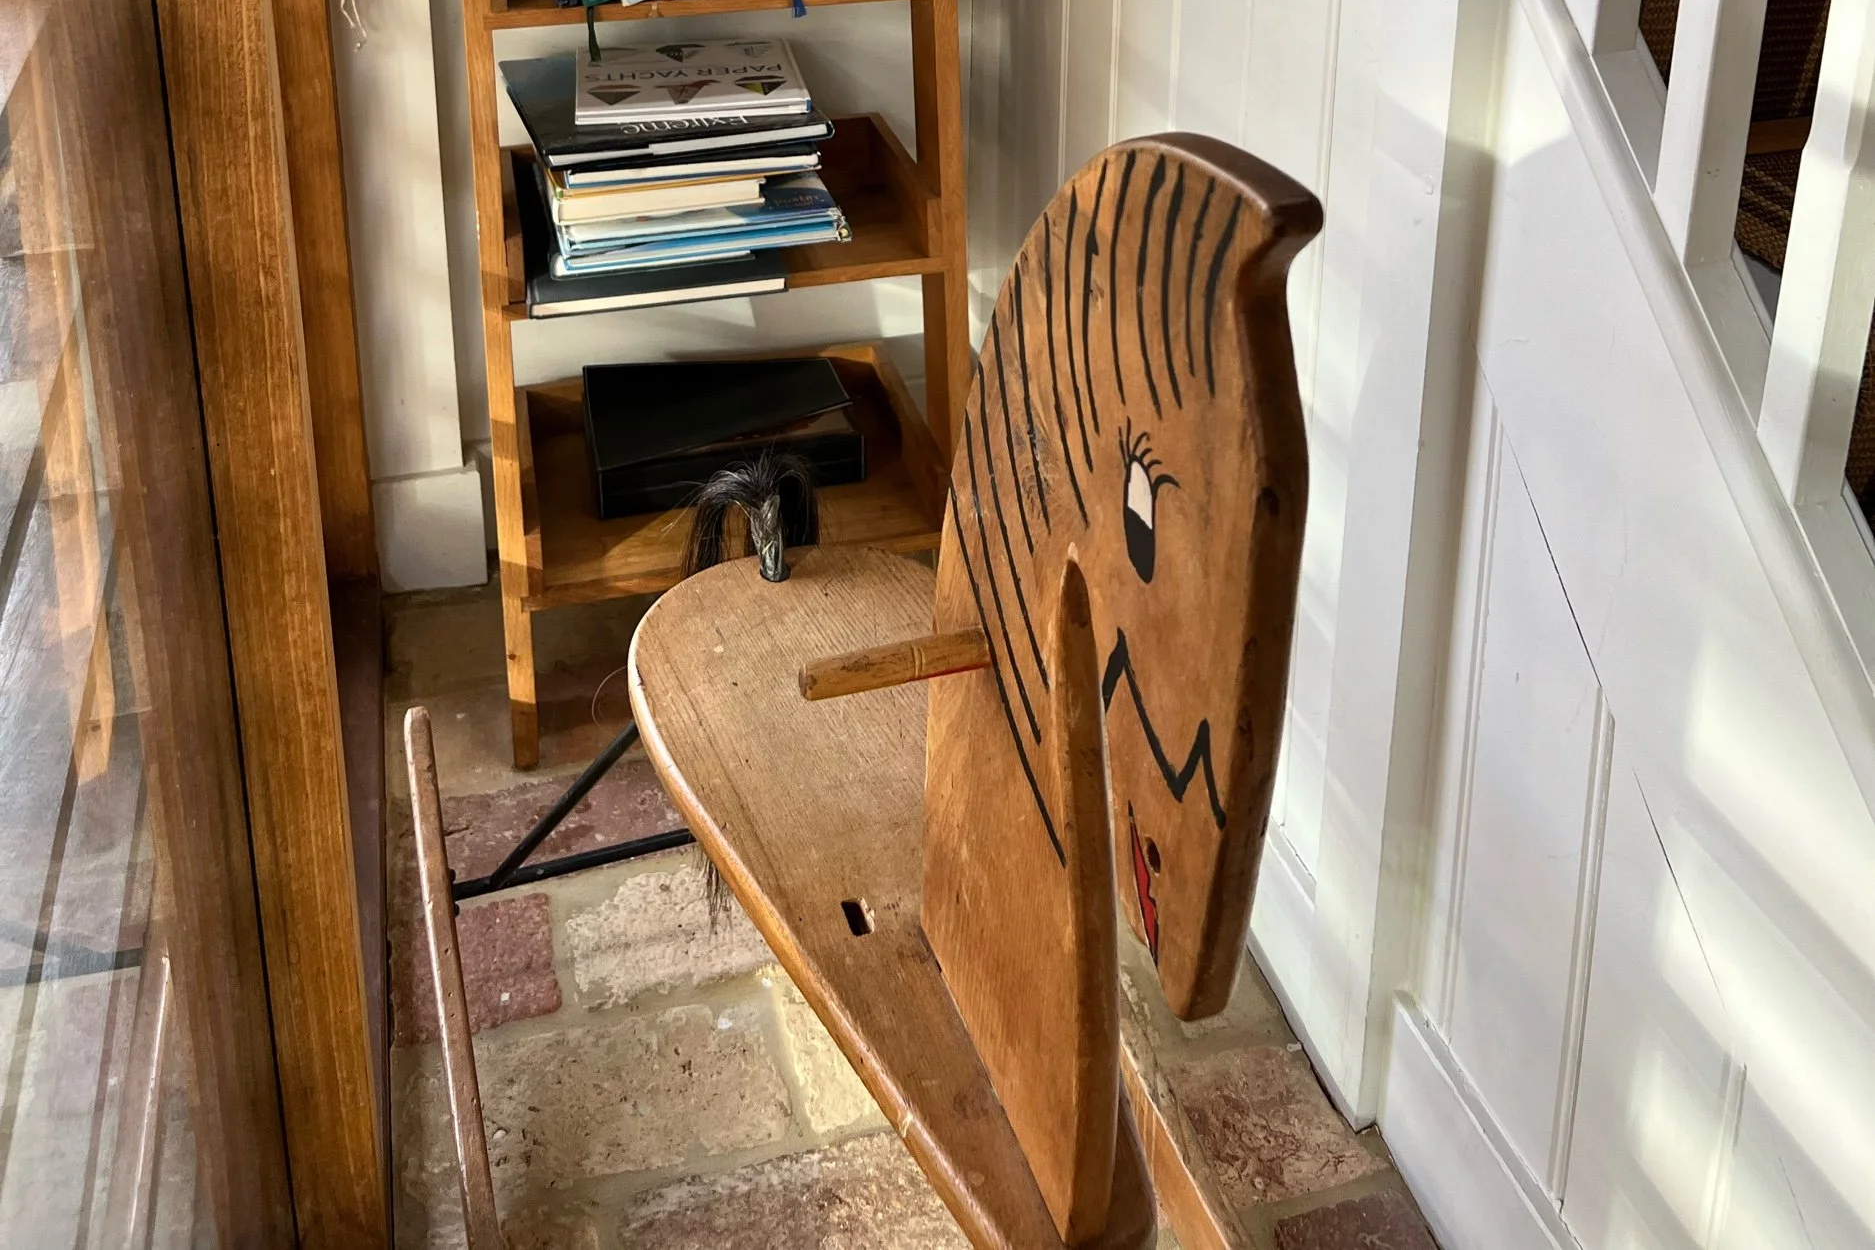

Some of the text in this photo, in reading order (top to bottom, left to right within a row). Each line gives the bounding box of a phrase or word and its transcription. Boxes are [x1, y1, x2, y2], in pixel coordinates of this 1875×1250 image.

[584, 64, 780, 81] PAPER YACHTS
[620, 115, 749, 133] Extreme
